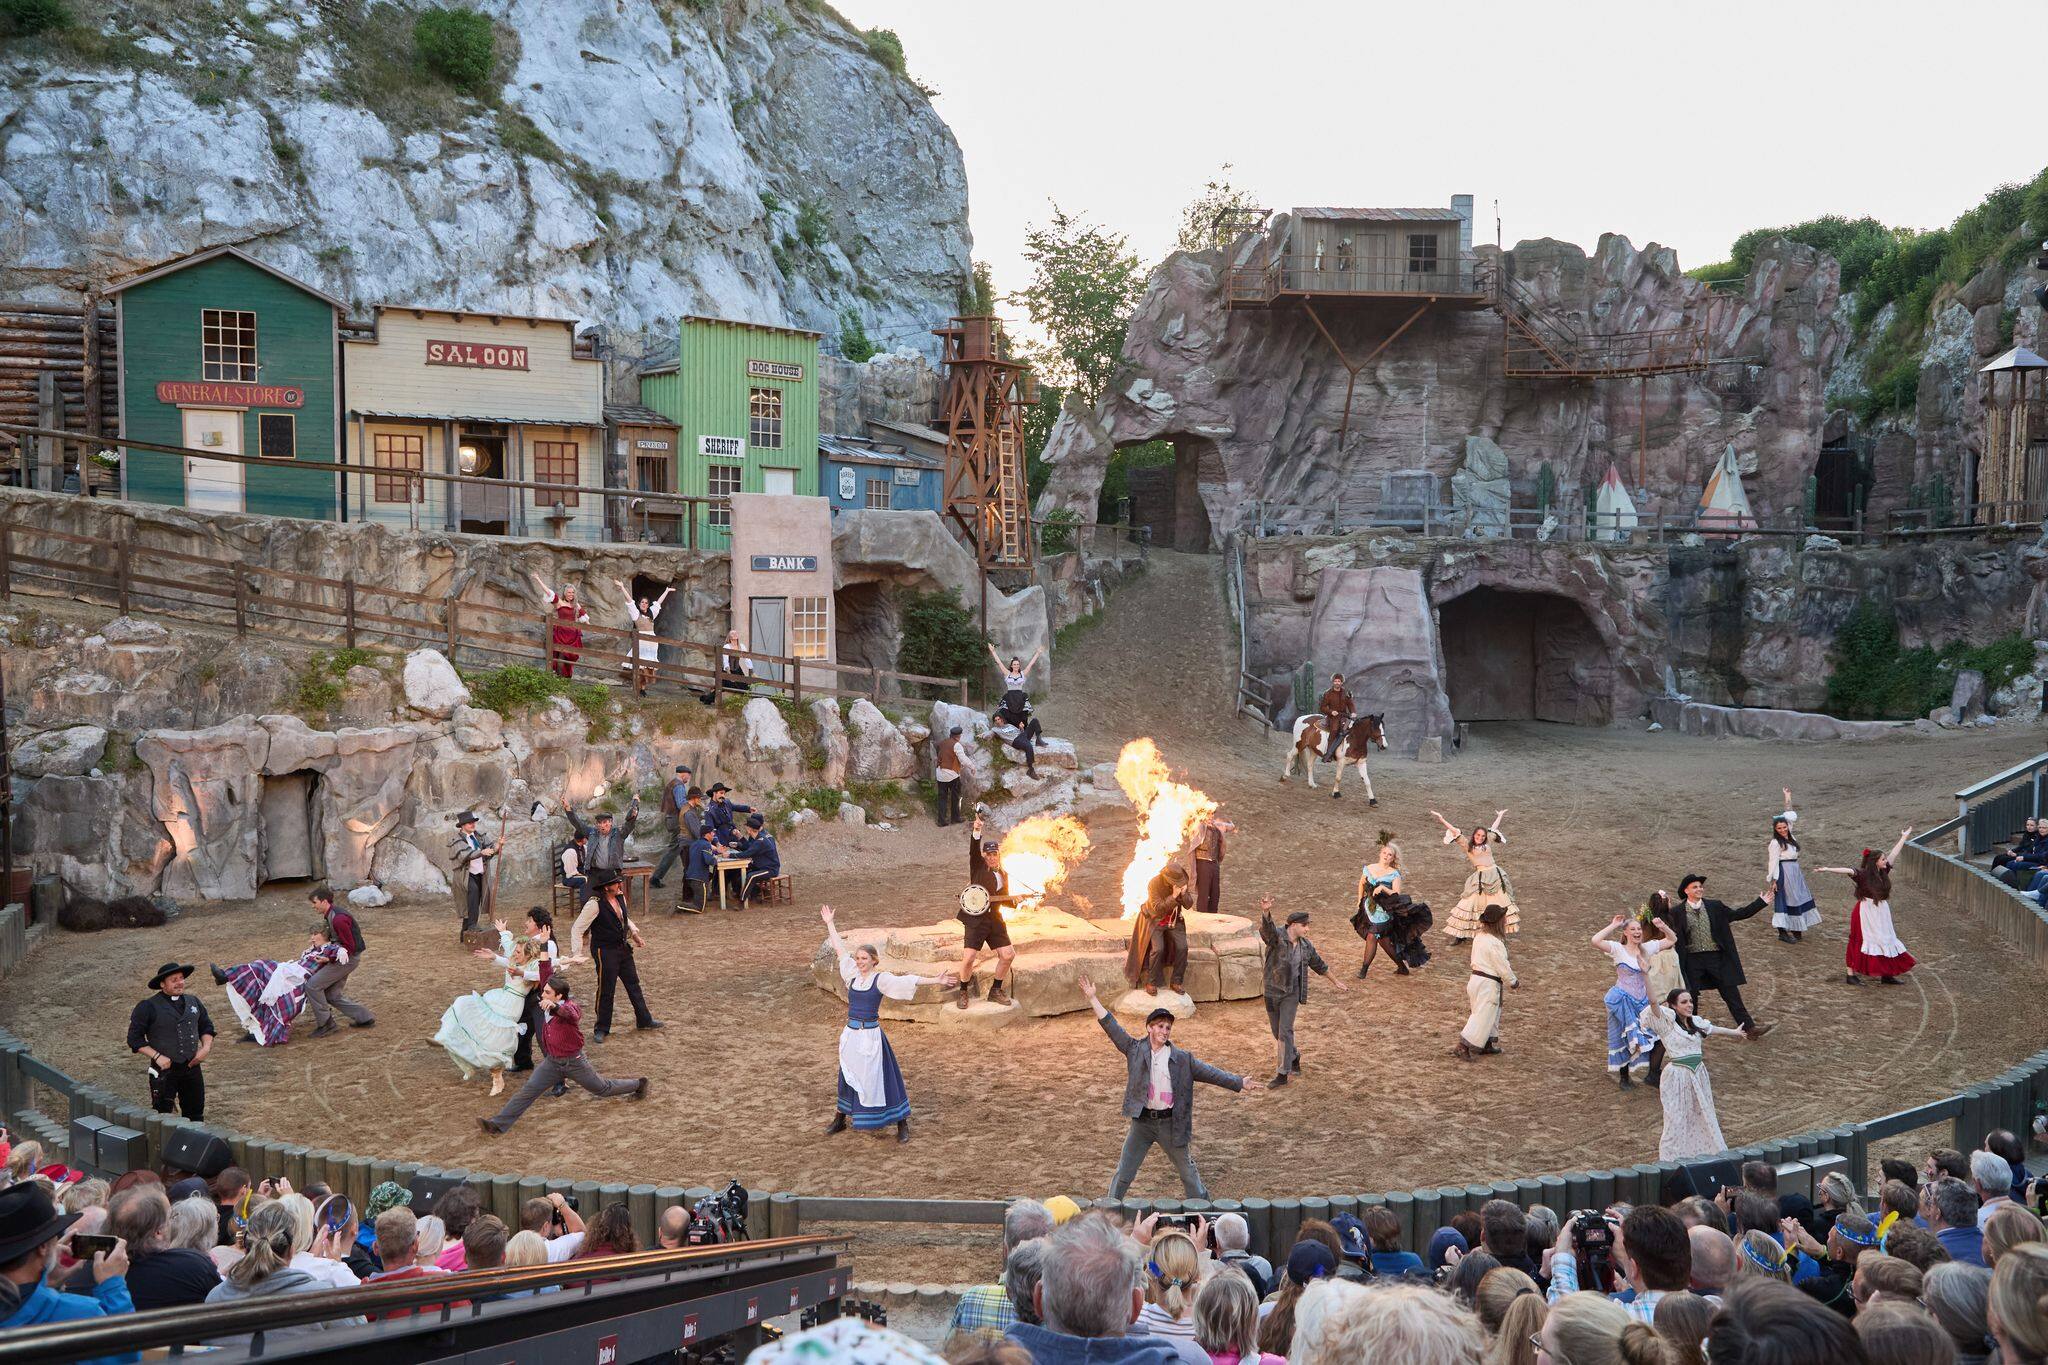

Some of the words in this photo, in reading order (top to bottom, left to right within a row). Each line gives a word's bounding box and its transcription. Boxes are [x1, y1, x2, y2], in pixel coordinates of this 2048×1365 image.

[429, 344, 525, 367] SALOON
[752, 362, 770, 373] DOC
[771, 364, 799, 376] HOUSE
[161, 384, 233, 402] GENERAL
[234, 386, 283, 405] STORE
[640, 441, 667, 449] PRISON
[705, 437, 739, 456] SHERIFF
[769, 557, 806, 570] BANK
